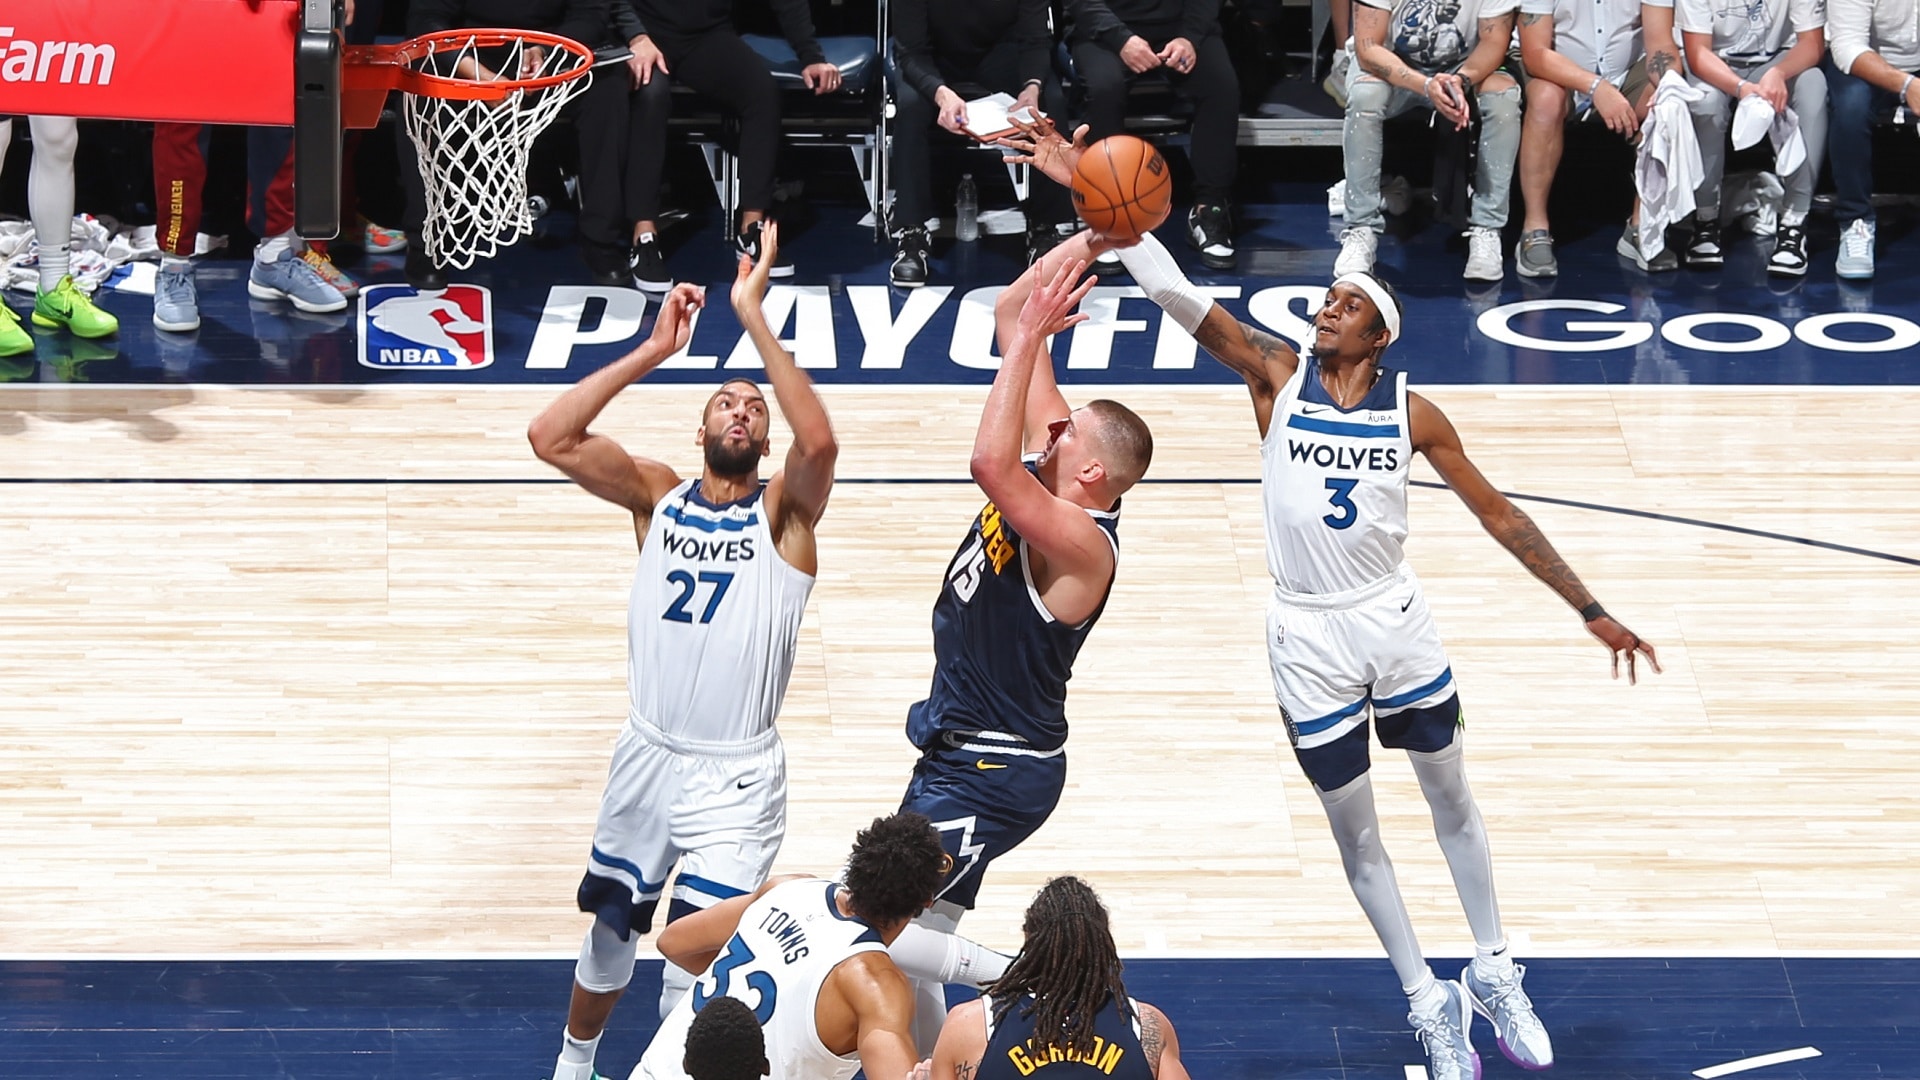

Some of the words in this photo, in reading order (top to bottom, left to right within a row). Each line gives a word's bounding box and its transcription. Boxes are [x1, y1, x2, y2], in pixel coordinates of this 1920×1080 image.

[171, 180, 183, 215] DENVER
[380, 348, 442, 364] NBA
[1288, 439, 1398, 472] WOLVES
[1323, 477, 1361, 530] 3
[662, 528, 755, 562] WOLVES
[661, 568, 735, 624] 27
[758, 906, 809, 965] TOWNS
